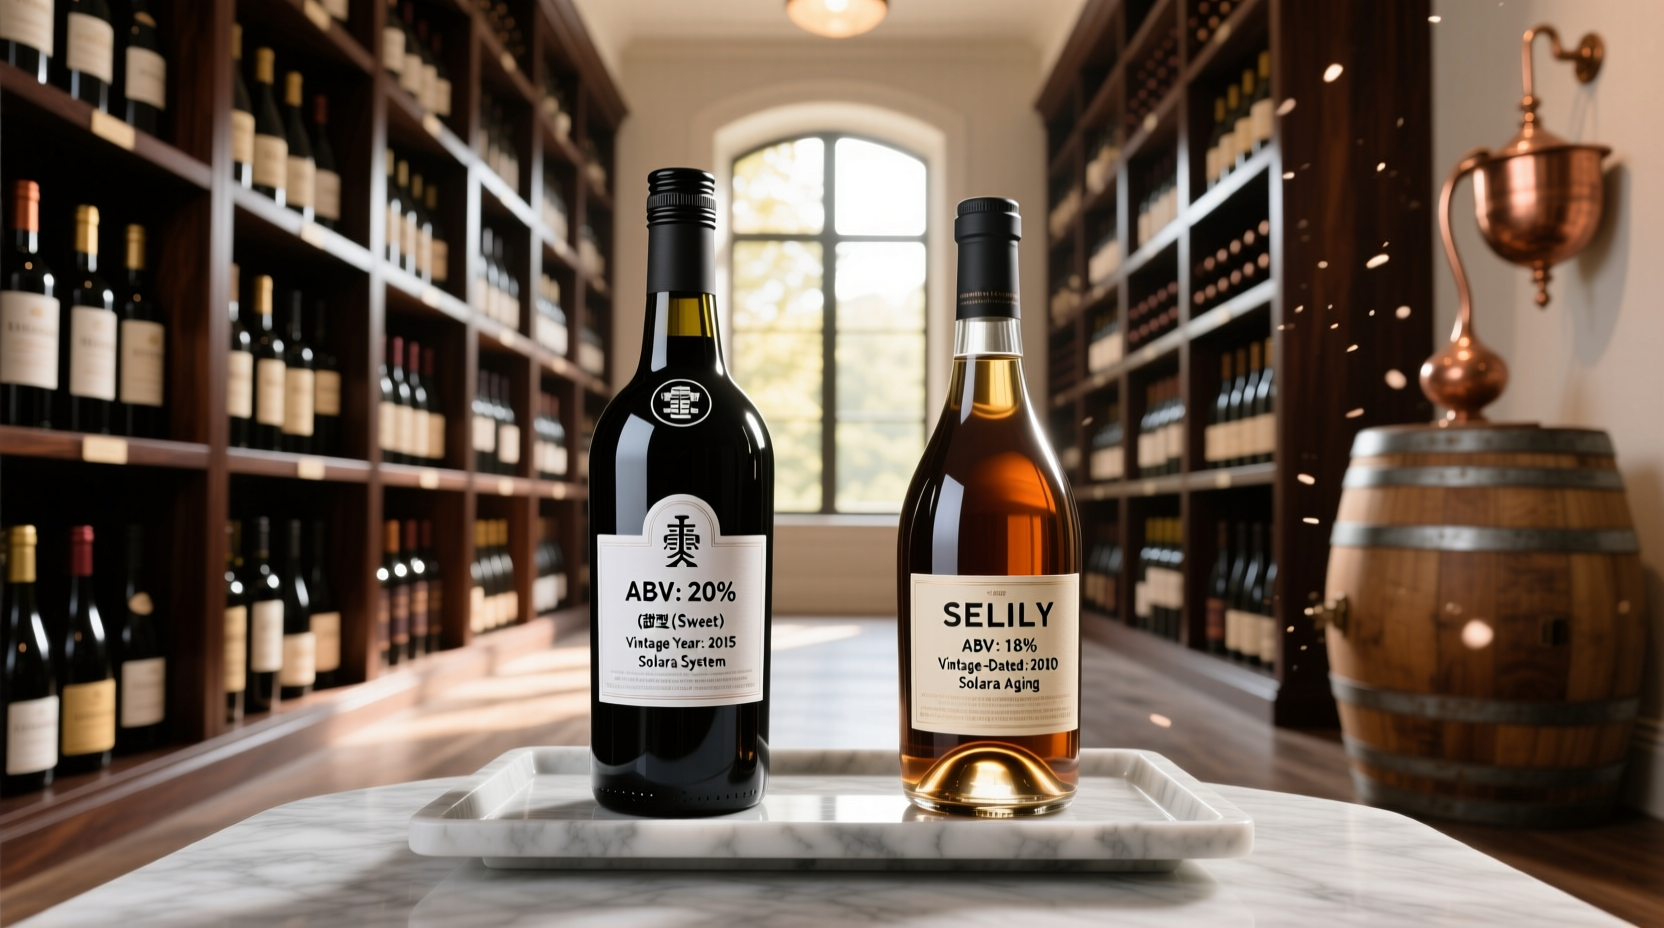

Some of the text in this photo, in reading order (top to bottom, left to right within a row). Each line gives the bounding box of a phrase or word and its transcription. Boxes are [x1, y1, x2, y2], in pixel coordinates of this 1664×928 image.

[625, 580, 737, 602] ABV: 20%
[943, 601, 1054, 628] SELILY
[626, 635, 737, 652] Vintage Year: 2015
[962, 637, 1038, 653] ABV: 18%
[638, 654, 678, 669] Solara
[959, 676, 1040, 693] Solara Aging
